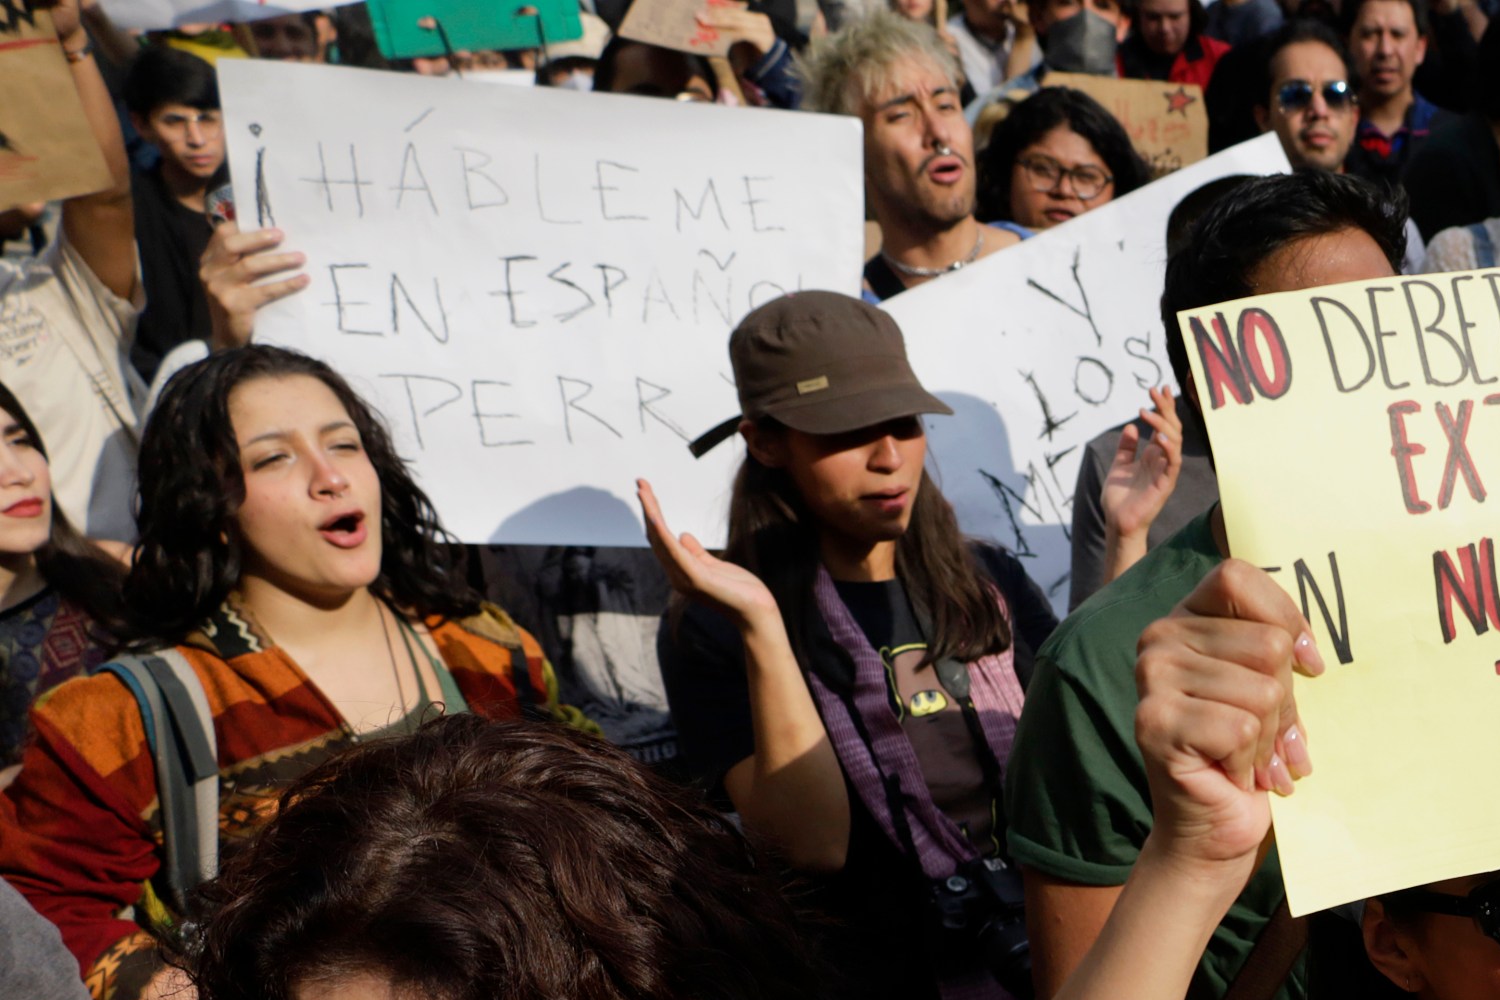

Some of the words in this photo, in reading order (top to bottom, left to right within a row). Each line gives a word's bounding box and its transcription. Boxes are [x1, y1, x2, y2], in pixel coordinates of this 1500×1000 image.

[324, 262, 449, 345] EN
[1026, 244, 1104, 348] Y
[1189, 307, 1293, 410] NO
[377, 371, 739, 451] PERR
